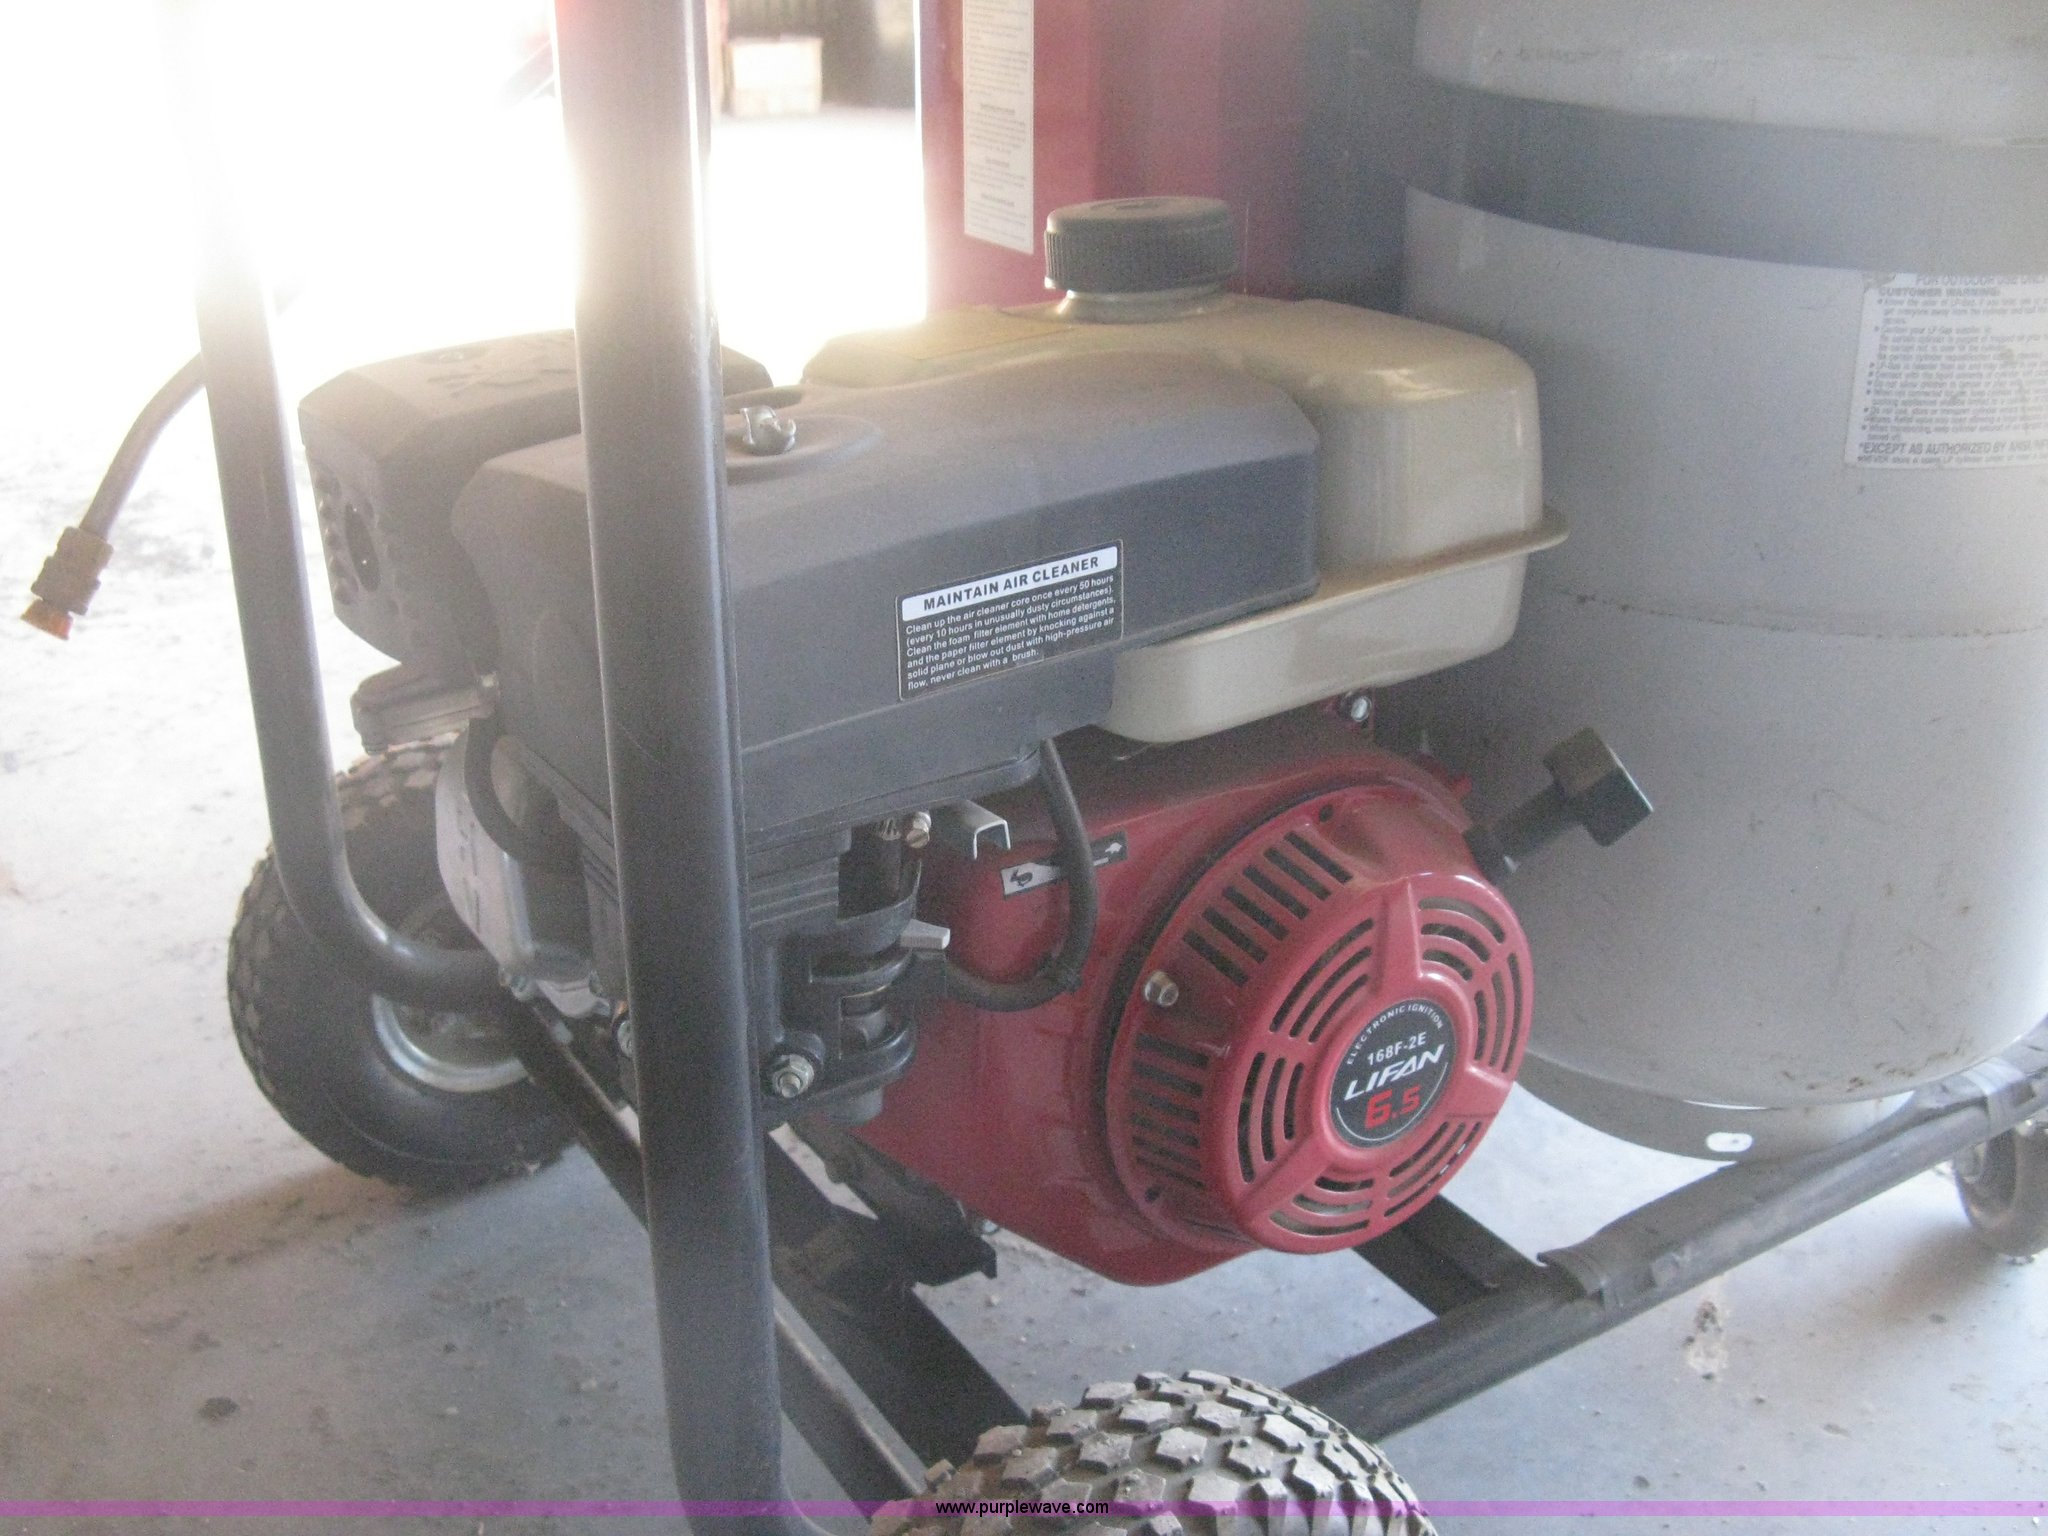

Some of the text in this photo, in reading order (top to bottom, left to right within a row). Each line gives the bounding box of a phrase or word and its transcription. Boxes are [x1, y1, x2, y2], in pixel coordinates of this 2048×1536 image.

[1878, 287, 1941, 296] CUSTOMER
[1908, 442, 1923, 454] AS
[1925, 442, 1992, 455] AUTHORIZED
[1993, 441, 2008, 453] BY
[906, 575, 1114, 635] Clean up the air cleaner core once every 50 hours
[924, 556, 1099, 611] MAINTAIN AIR CLEANER
[906, 633, 934, 648] (every
[936, 627, 947, 639] 10
[949, 622, 973, 635] hours
[975, 618, 983, 628] in
[984, 607, 1025, 626] unusually
[1027, 602, 1049, 615] dusty
[907, 644, 932, 657] Clean
[934, 639, 947, 649] the
[949, 635, 971, 646] foam
[974, 628, 993, 639] filter
[995, 618, 1028, 634] element
[1030, 613, 1047, 625] with
[1048, 608, 1071, 620] home
[907, 656, 924, 668] and
[926, 651, 940, 661] the
[942, 646, 967, 661] paper
[969, 640, 988, 652] filter
[991, 630, 1025, 647] element
[1027, 626, 1038, 636] by
[1039, 616, 1077, 632] knocking
[1078, 607, 1108, 623] against
[907, 617, 1114, 680] solid plane or blow out dust with high-pressure air
[930, 671, 956, 684] never
[957, 664, 981, 677] clean
[983, 658, 1001, 670] with
[1003, 657, 1009, 665] a
[1012, 649, 1039, 661] brush.
[1346, 1003, 1443, 1065] ELECTRONIC IGNITION
[1368, 1031, 1427, 1065] 168F-2E
[1344, 1044, 1445, 1101] LIFAN
[1365, 1084, 1421, 1129] 6.5
